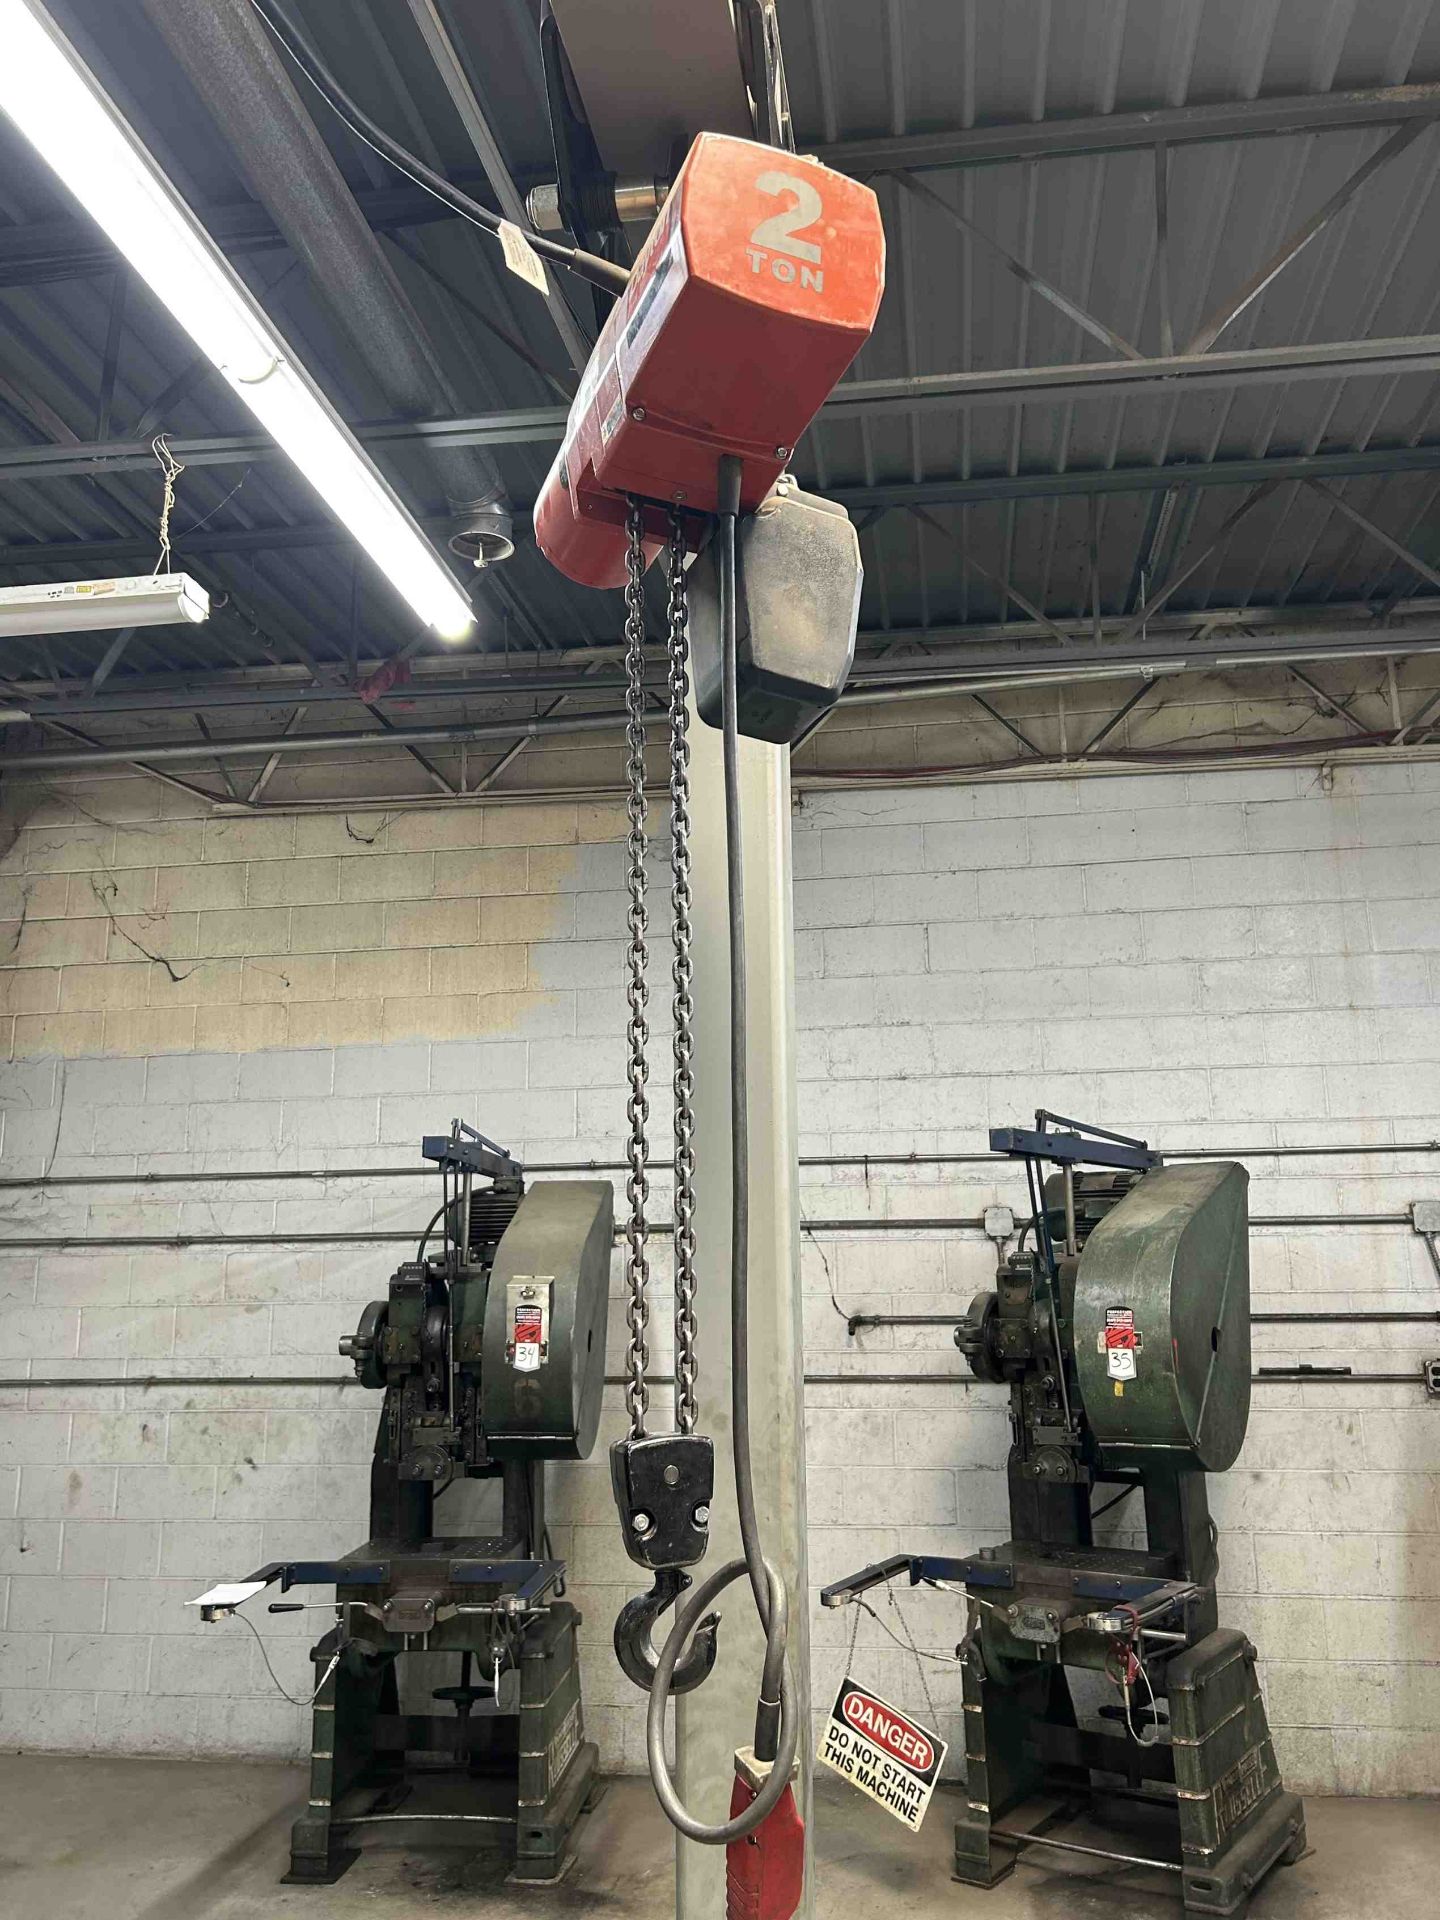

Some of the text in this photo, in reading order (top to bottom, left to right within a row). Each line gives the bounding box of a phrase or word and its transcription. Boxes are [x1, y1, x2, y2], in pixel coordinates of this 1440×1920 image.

[750, 171, 823, 265] 2
[745, 249, 823, 293] TON
[517, 1346, 536, 1367] 34
[1111, 1352, 1132, 1370] 35
[829, 1726, 926, 1804] DO NOT START
[847, 1696, 929, 1767] DANGER
[824, 1742, 919, 1823] THIS MACHINE
